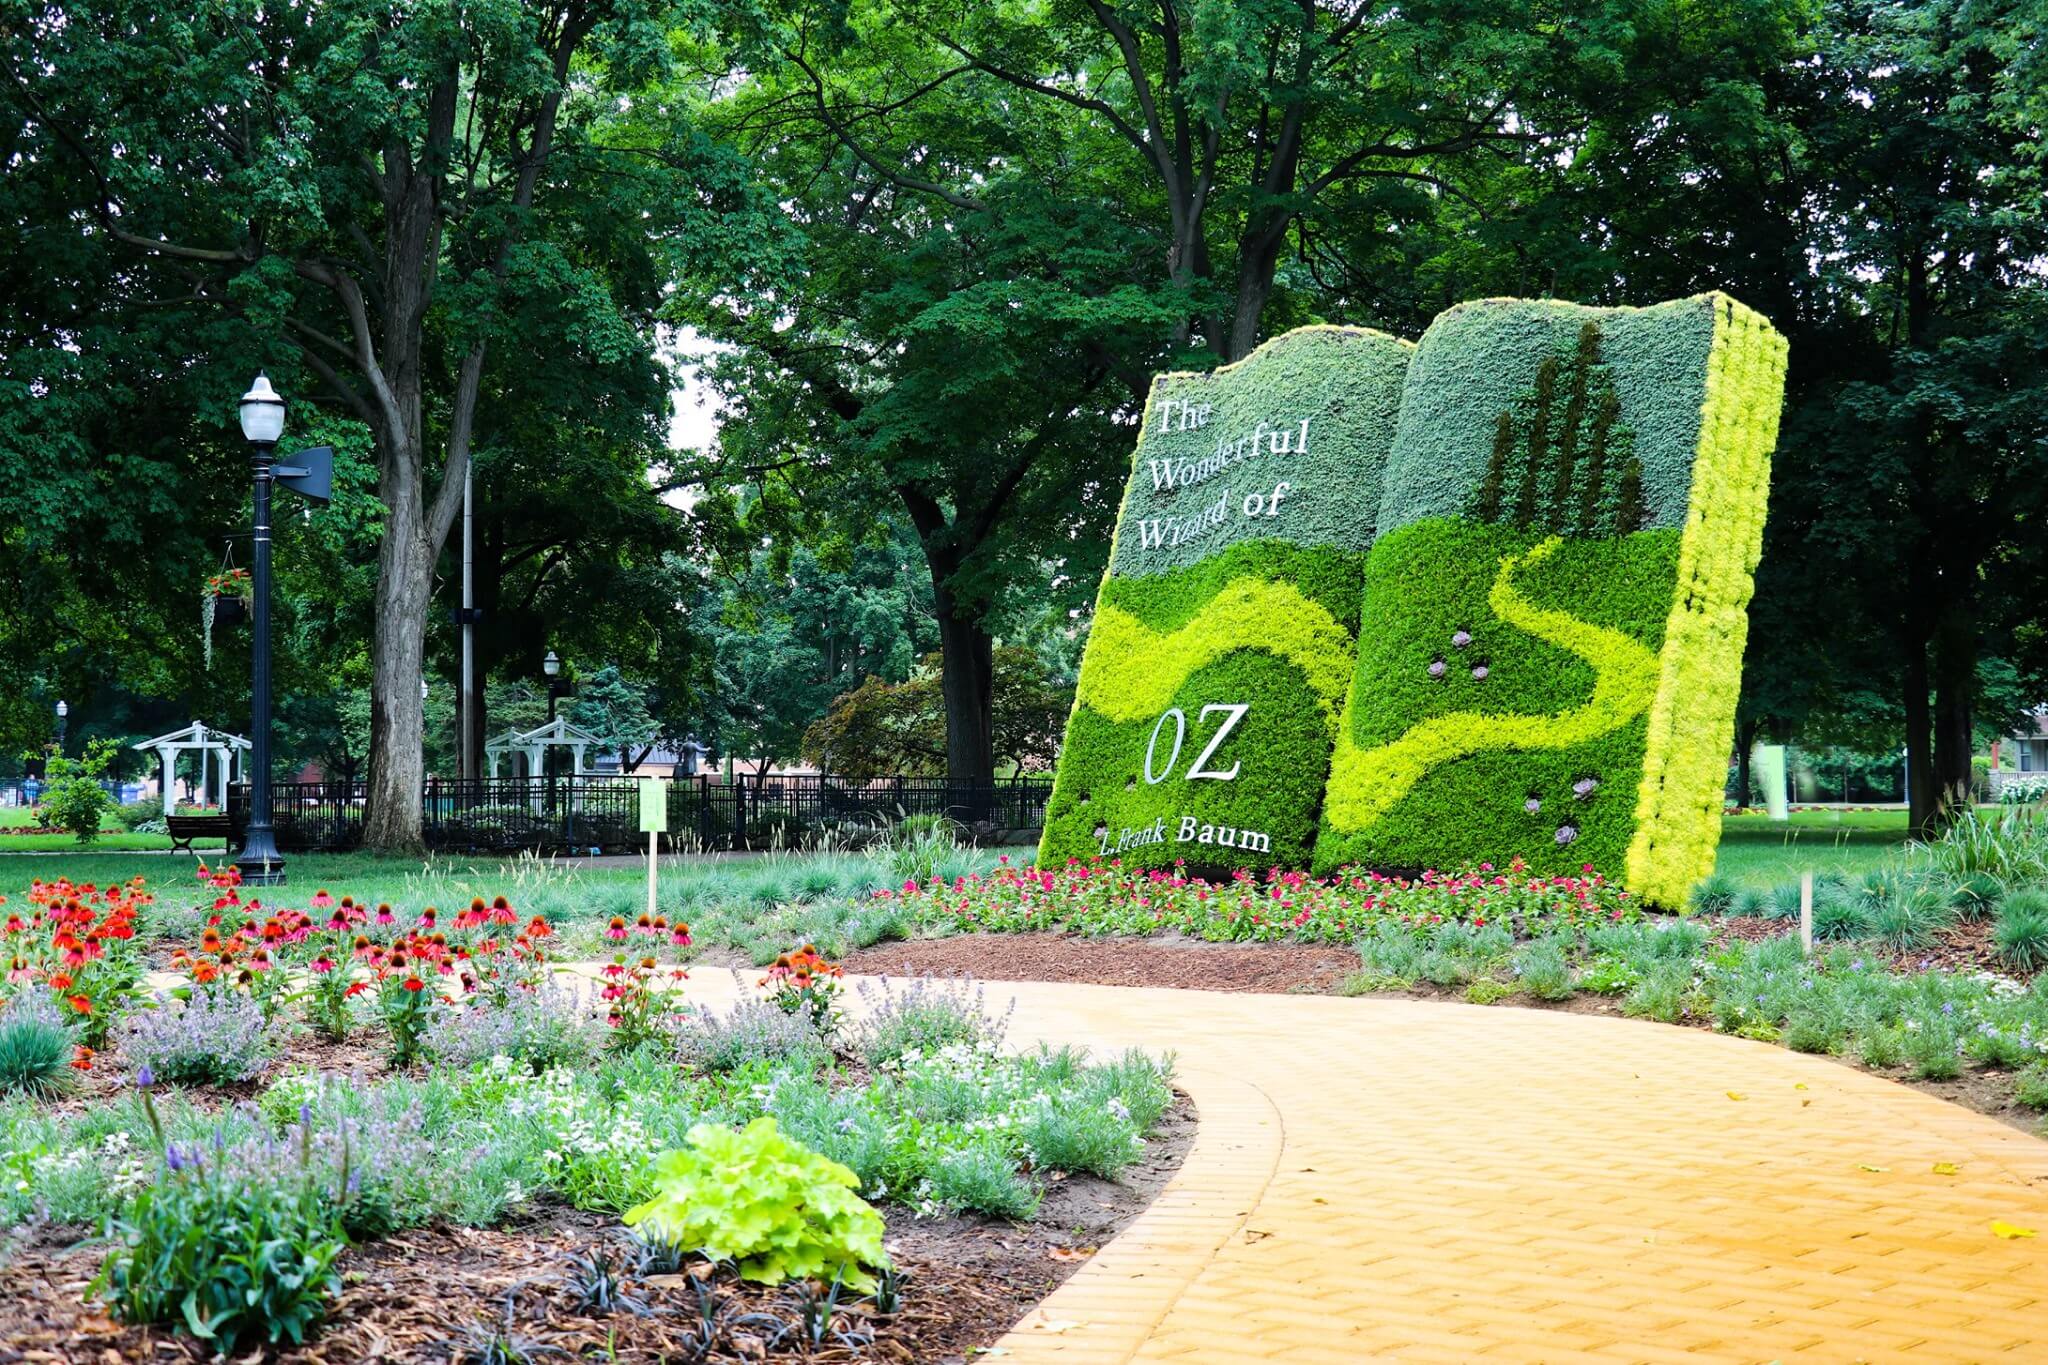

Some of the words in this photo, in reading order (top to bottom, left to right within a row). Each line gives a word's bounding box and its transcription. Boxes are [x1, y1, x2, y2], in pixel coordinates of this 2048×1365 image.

[1156, 400, 1211, 432] The
[1148, 419, 1312, 491] Wonderful
[1137, 489, 1230, 550] Wizard
[1243, 481, 1290, 517] of
[1144, 704, 1249, 784] OZ
[1175, 816, 1271, 853] Baum
